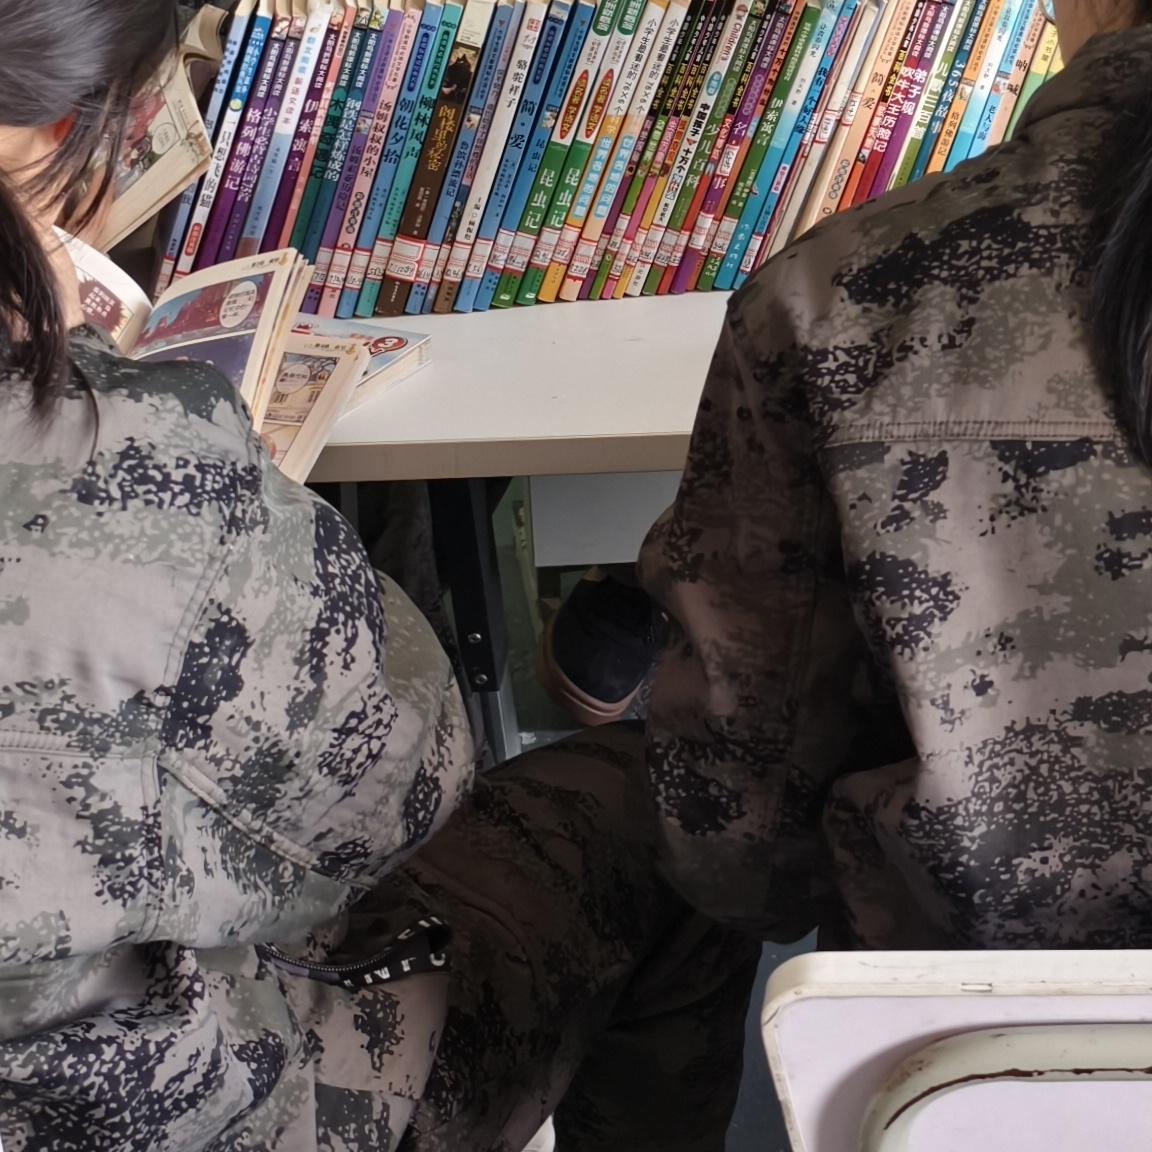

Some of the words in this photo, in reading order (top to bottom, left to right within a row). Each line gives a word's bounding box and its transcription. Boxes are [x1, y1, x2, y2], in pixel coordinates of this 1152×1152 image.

[506, 59, 528, 108] 骆驼祥子
[902, 68, 928, 116] 弟子规
[911, 63, 948, 140] 儿歌三百首
[931, 59, 966, 134] 365夜故事
[1007, 59, 1029, 96] 呐喊
[287, 99, 319, 172] 伊索寓言
[324, 99, 362, 182] 钢铁是怎样炼成的
[360, 100, 392, 177] 汤姆叔叔的小屋
[383, 98, 414, 165] 朝花夕拾
[404, 95, 436, 159] 柳林风声
[757, 98, 783, 145] 伊索寓言
[874, 67, 915, 153] 吹牛大王历险记
[938, 112, 960, 157] 格列佛游记
[977, 105, 997, 141] 老人与海
[224, 108, 263, 191] 格列佛游记
[528, 138, 546, 173] 昆虫记
[686, 123, 720, 189] 少儿百科
[525, 168, 555, 229] 昆虫记
[551, 168, 581, 228] 昆虫记
